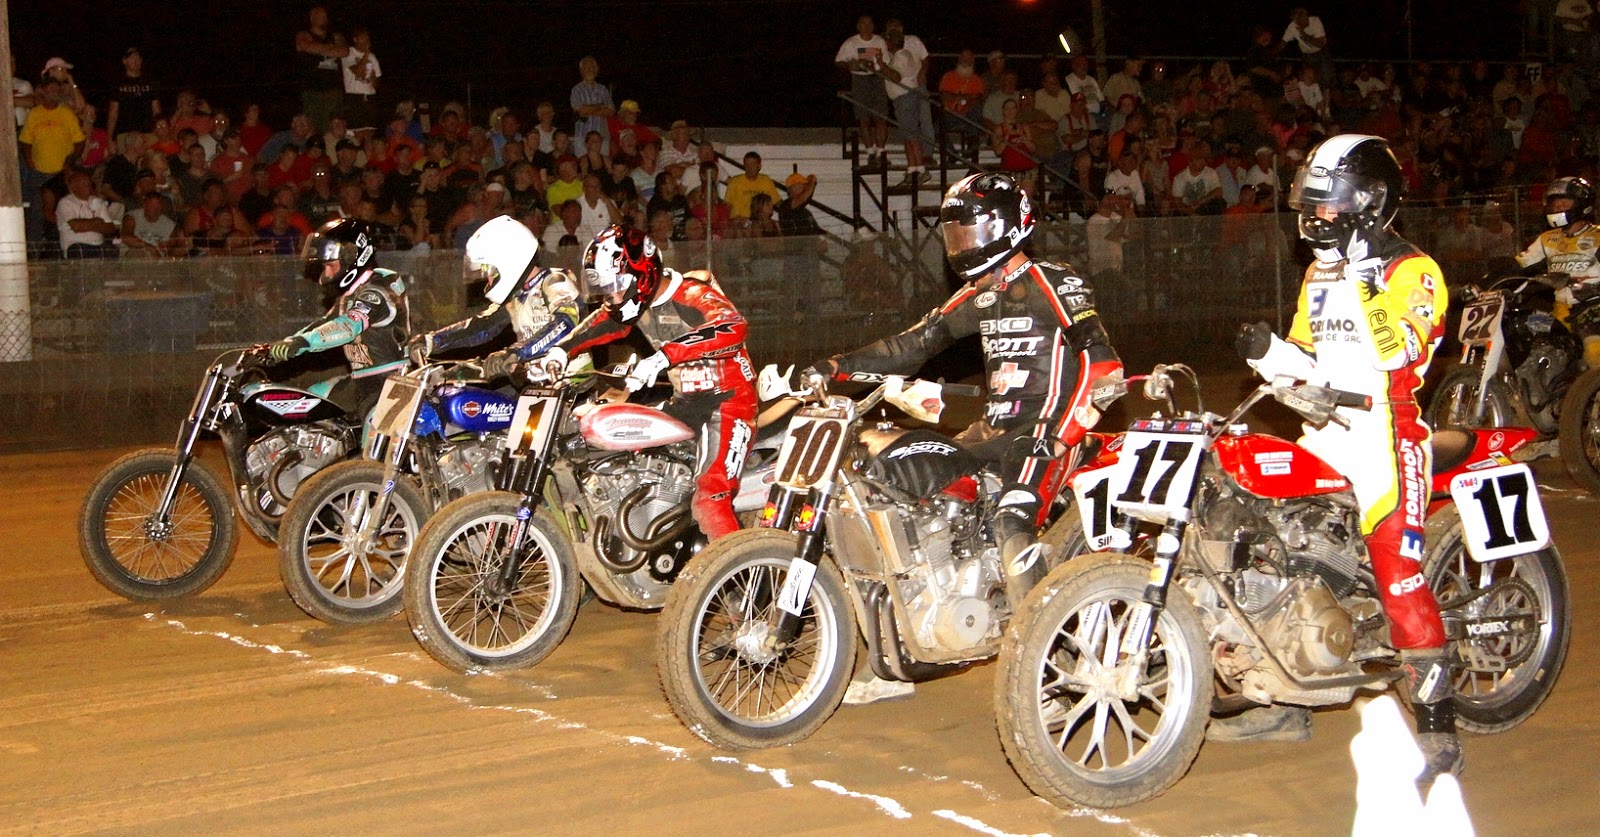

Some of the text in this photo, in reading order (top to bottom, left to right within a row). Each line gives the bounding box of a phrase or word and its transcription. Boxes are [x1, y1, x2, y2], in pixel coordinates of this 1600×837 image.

[1462, 304, 1501, 341] 27
[377, 383, 418, 431] 7
[482, 402, 514, 415] White's
[513, 399, 547, 455] 1
[779, 420, 842, 484] 10
[1117, 440, 1194, 505] 17
[1472, 472, 1537, 550] 17
